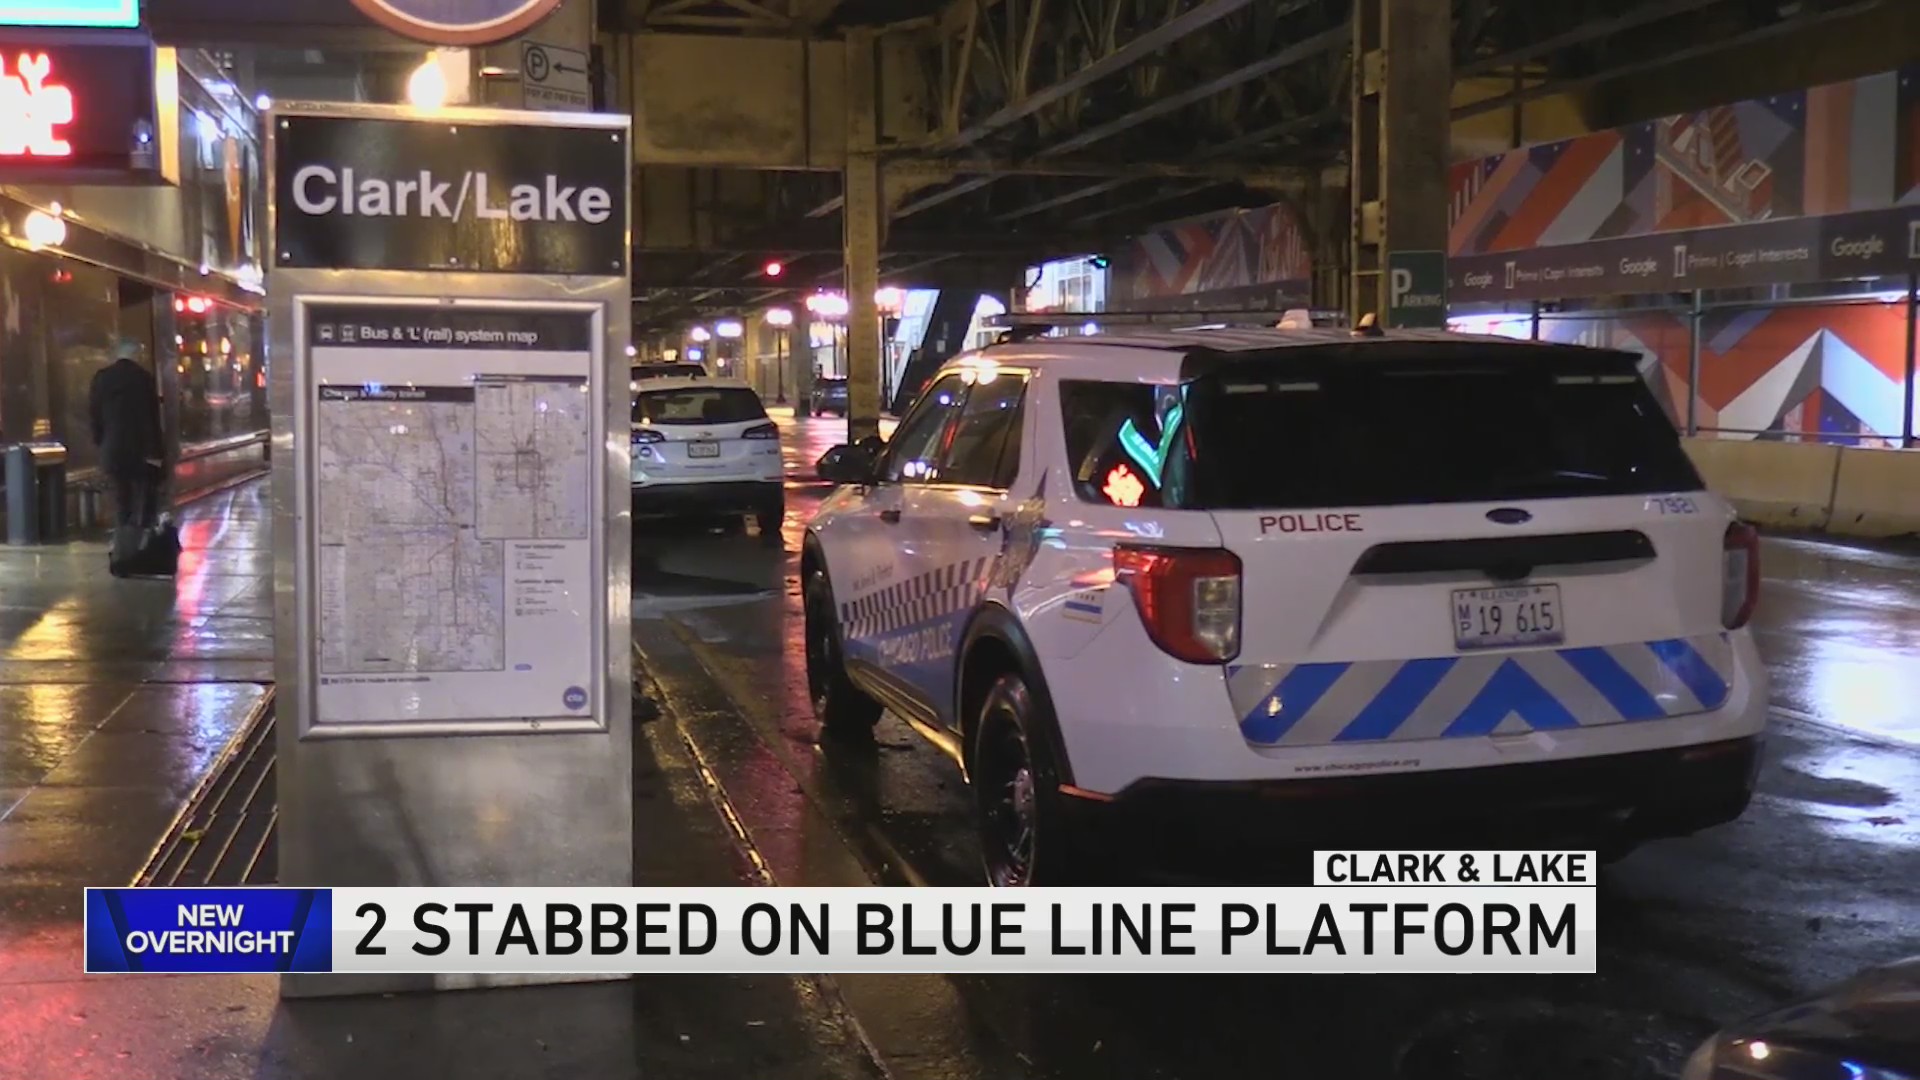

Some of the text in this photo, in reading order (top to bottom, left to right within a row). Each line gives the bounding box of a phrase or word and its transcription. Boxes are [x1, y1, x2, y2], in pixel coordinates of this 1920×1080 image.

[292, 165, 612, 224] Clark/Lake
[1688, 246, 1809, 269] Prime Capri Interests
[1831, 235, 1884, 260] Google
[1515, 268, 1538, 282] Prime
[1568, 264, 1605, 277] Interests
[1619, 257, 1658, 277] Google
[1463, 272, 1494, 289] Google
[360, 327, 389, 341] Bus
[393, 328, 404, 341] &
[423, 328, 453, 343] (rail)
[455, 330, 504, 345] system
[507, 332, 539, 345] map
[1651, 497, 1700, 515] 7921
[1259, 513, 1364, 535] POLICE
[1479, 601, 1554, 636] 19 615
